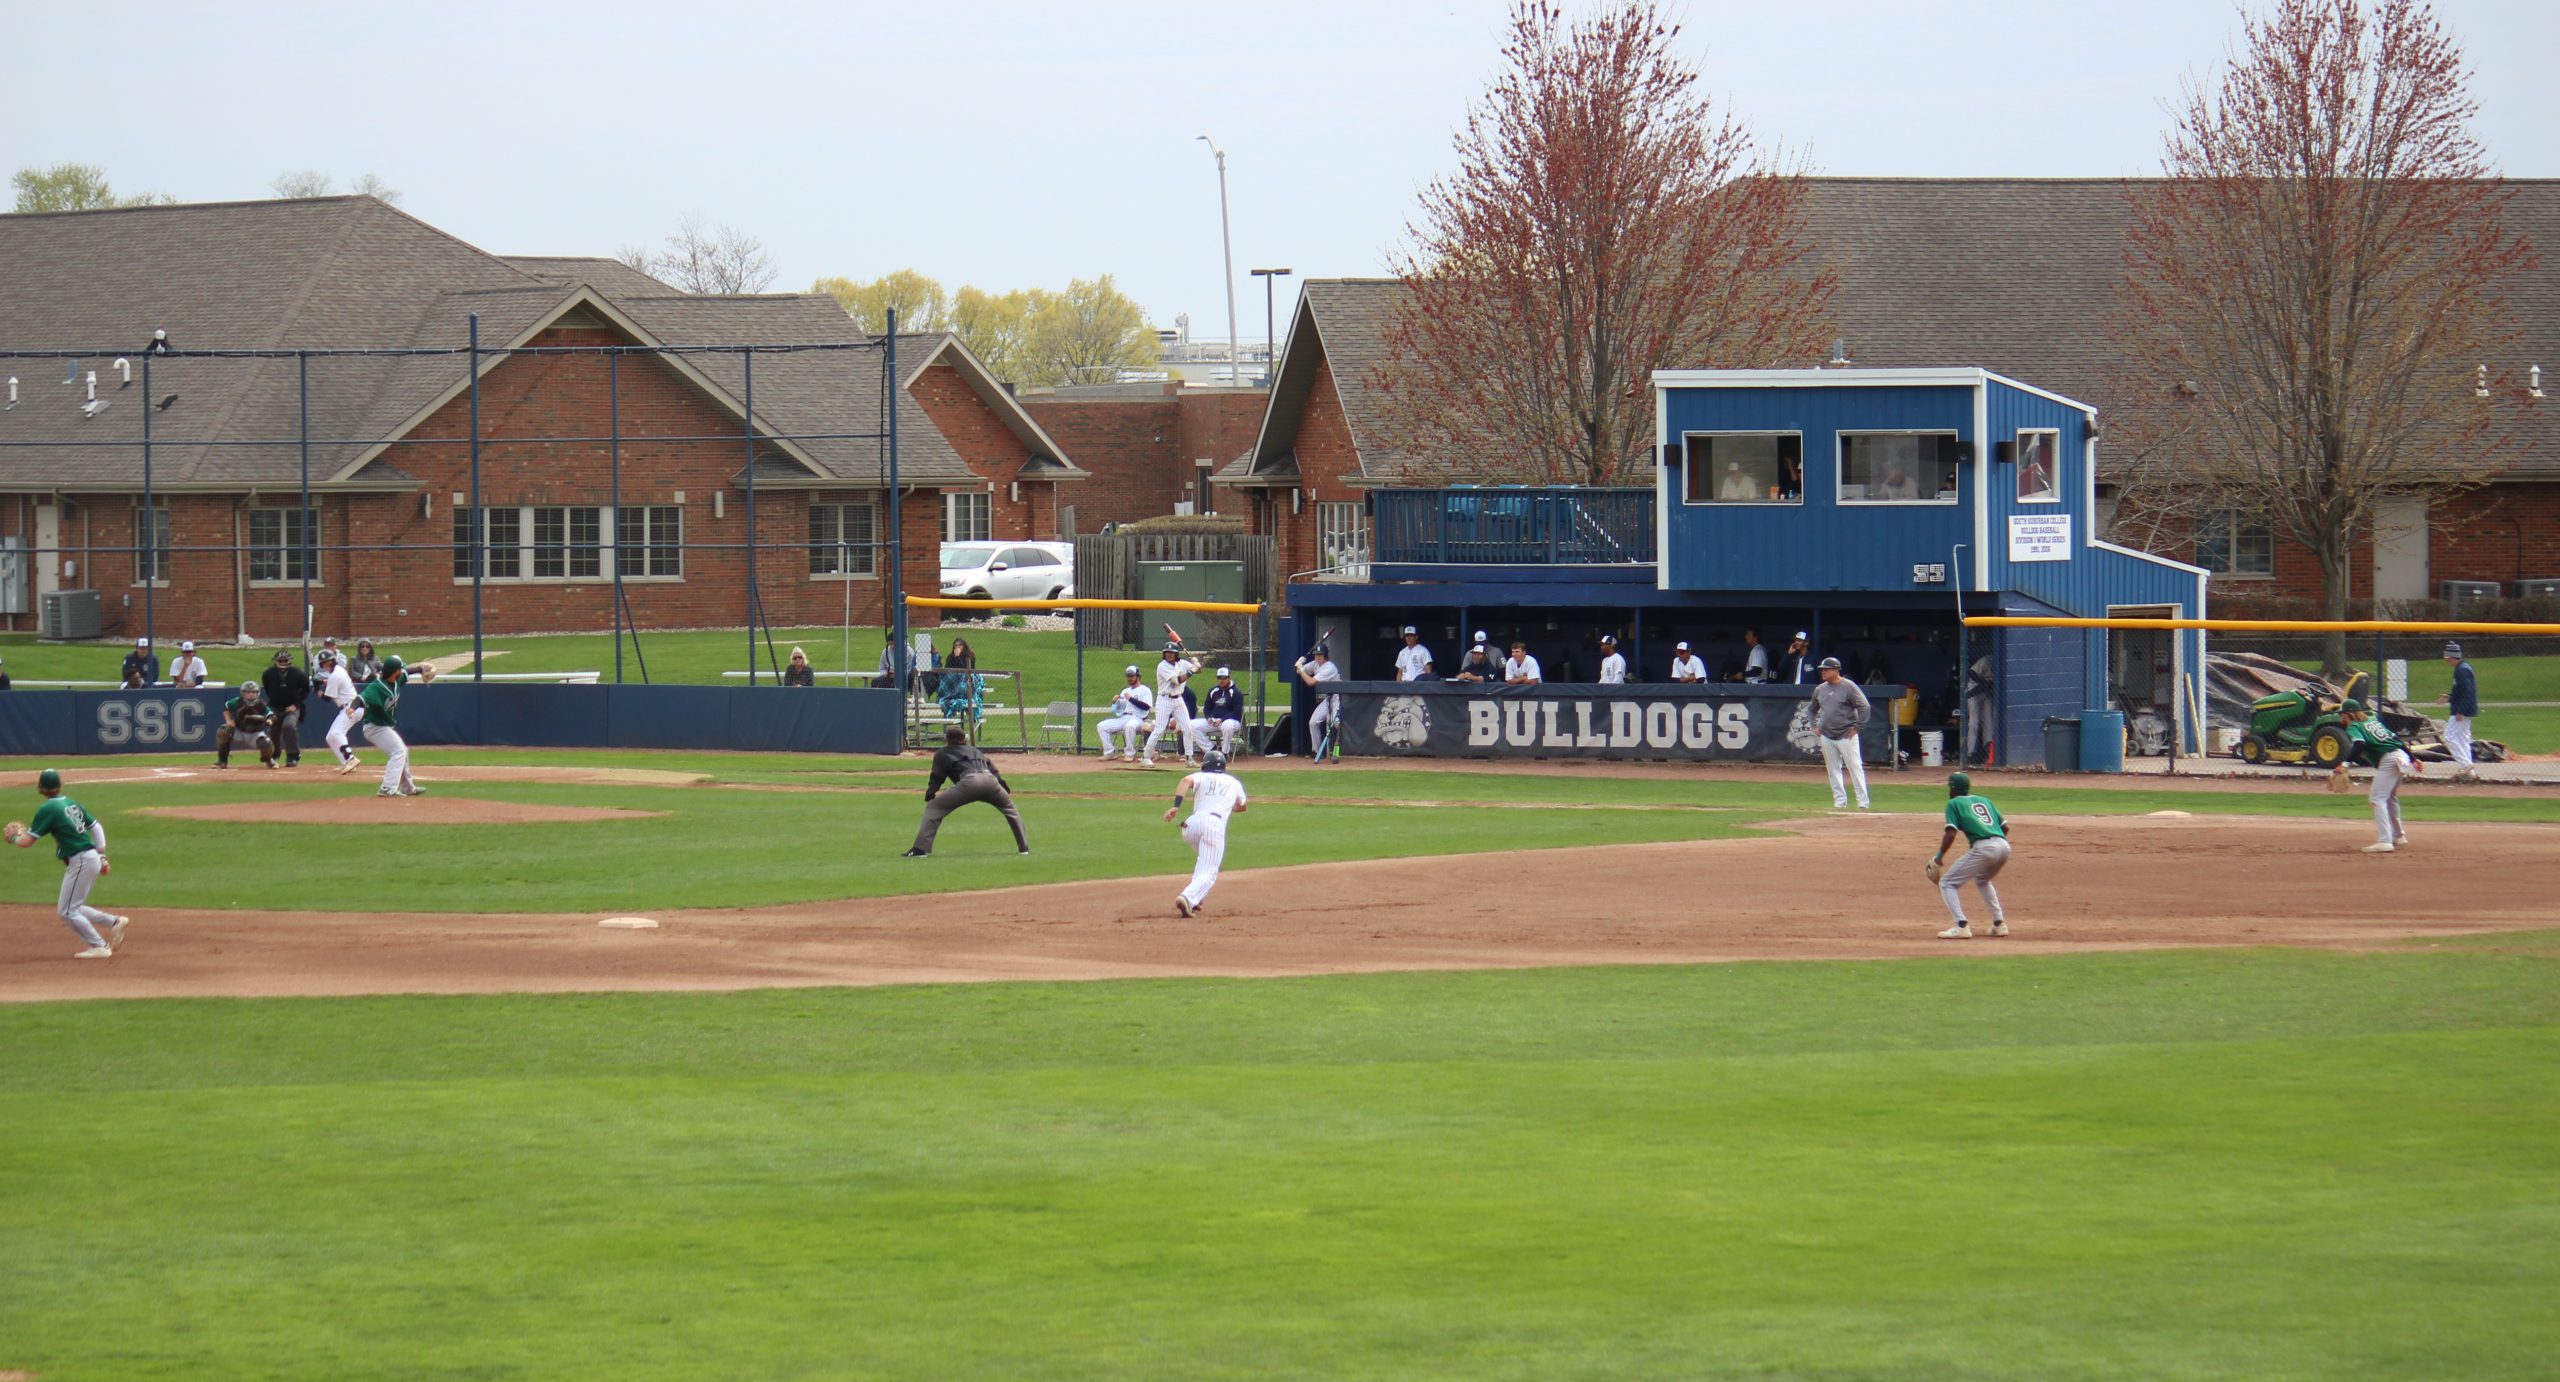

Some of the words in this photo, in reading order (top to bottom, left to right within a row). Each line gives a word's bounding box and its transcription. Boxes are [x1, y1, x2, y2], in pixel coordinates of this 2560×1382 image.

[97, 698, 206, 745] SSC
[1468, 700, 1750, 750] BULLDOGS
[1971, 802, 1994, 826] 9
